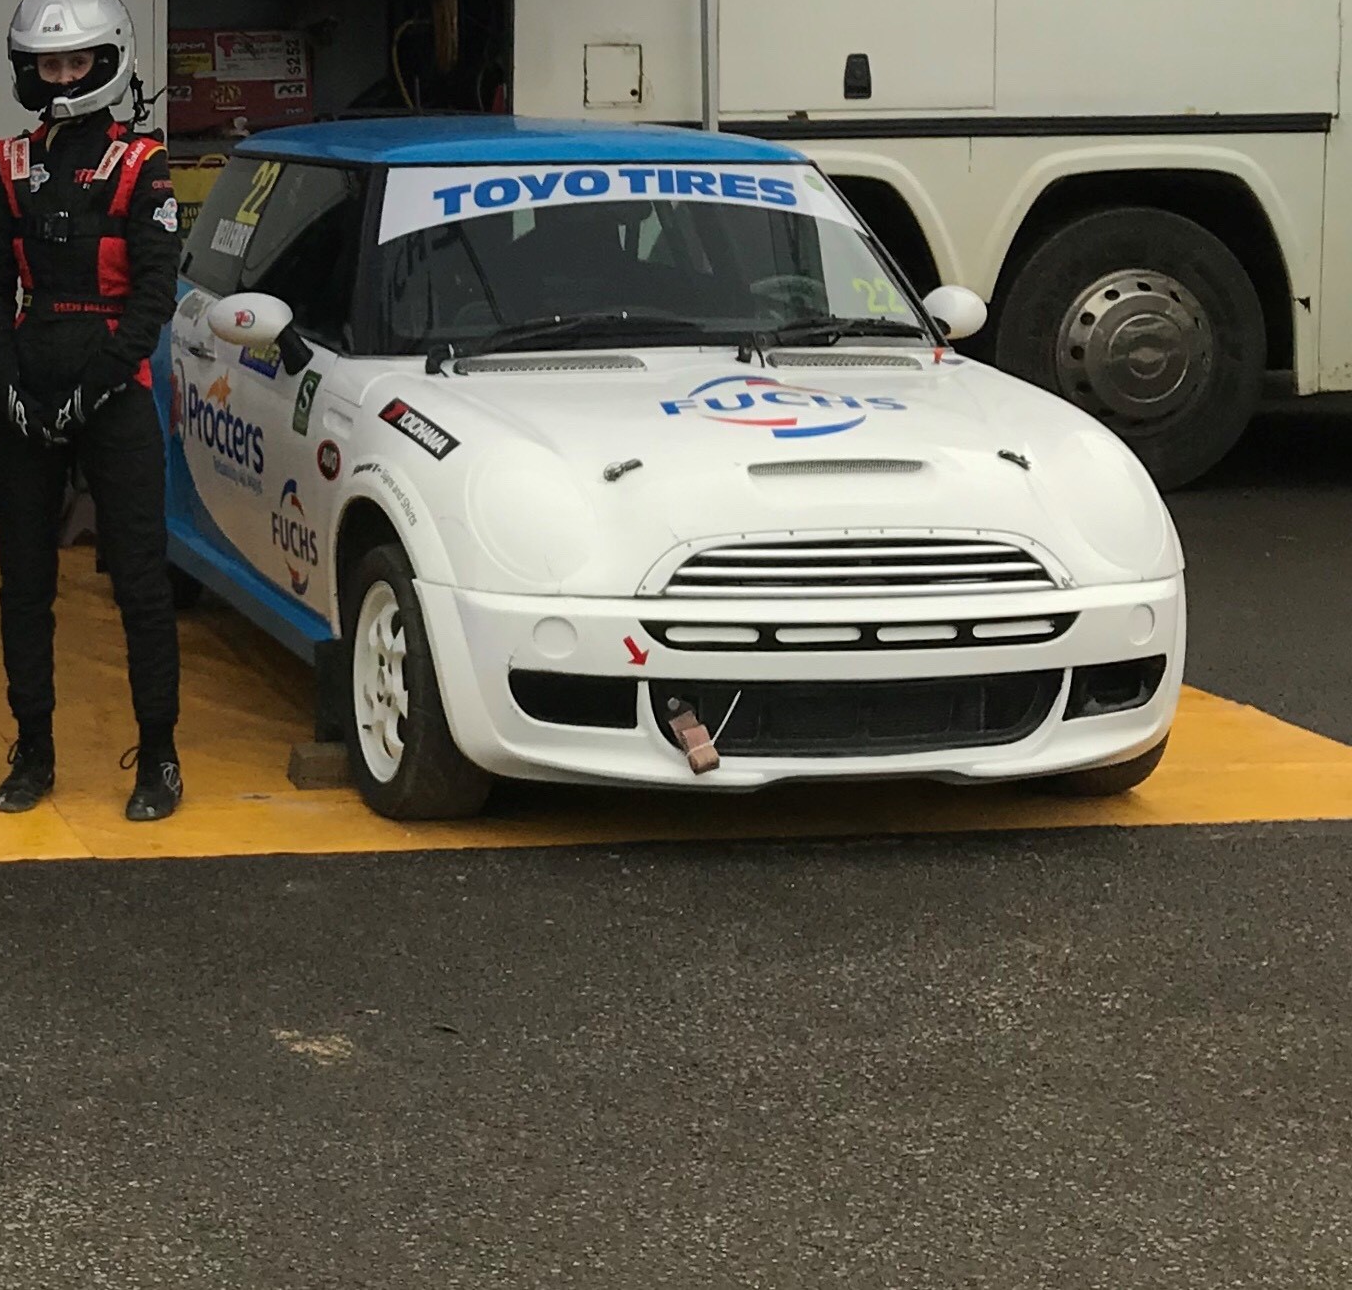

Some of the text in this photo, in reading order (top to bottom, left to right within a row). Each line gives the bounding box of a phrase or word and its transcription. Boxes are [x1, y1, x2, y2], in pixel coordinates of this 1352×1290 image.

[433, 168, 798, 216] TOYO TIRES
[852, 277, 906, 315] 22
[660, 390, 908, 415] FUCHS
[189, 382, 264, 475] Procters
[398, 410, 449, 455] YOKOHAMA
[271, 511, 319, 567] FUCHS
